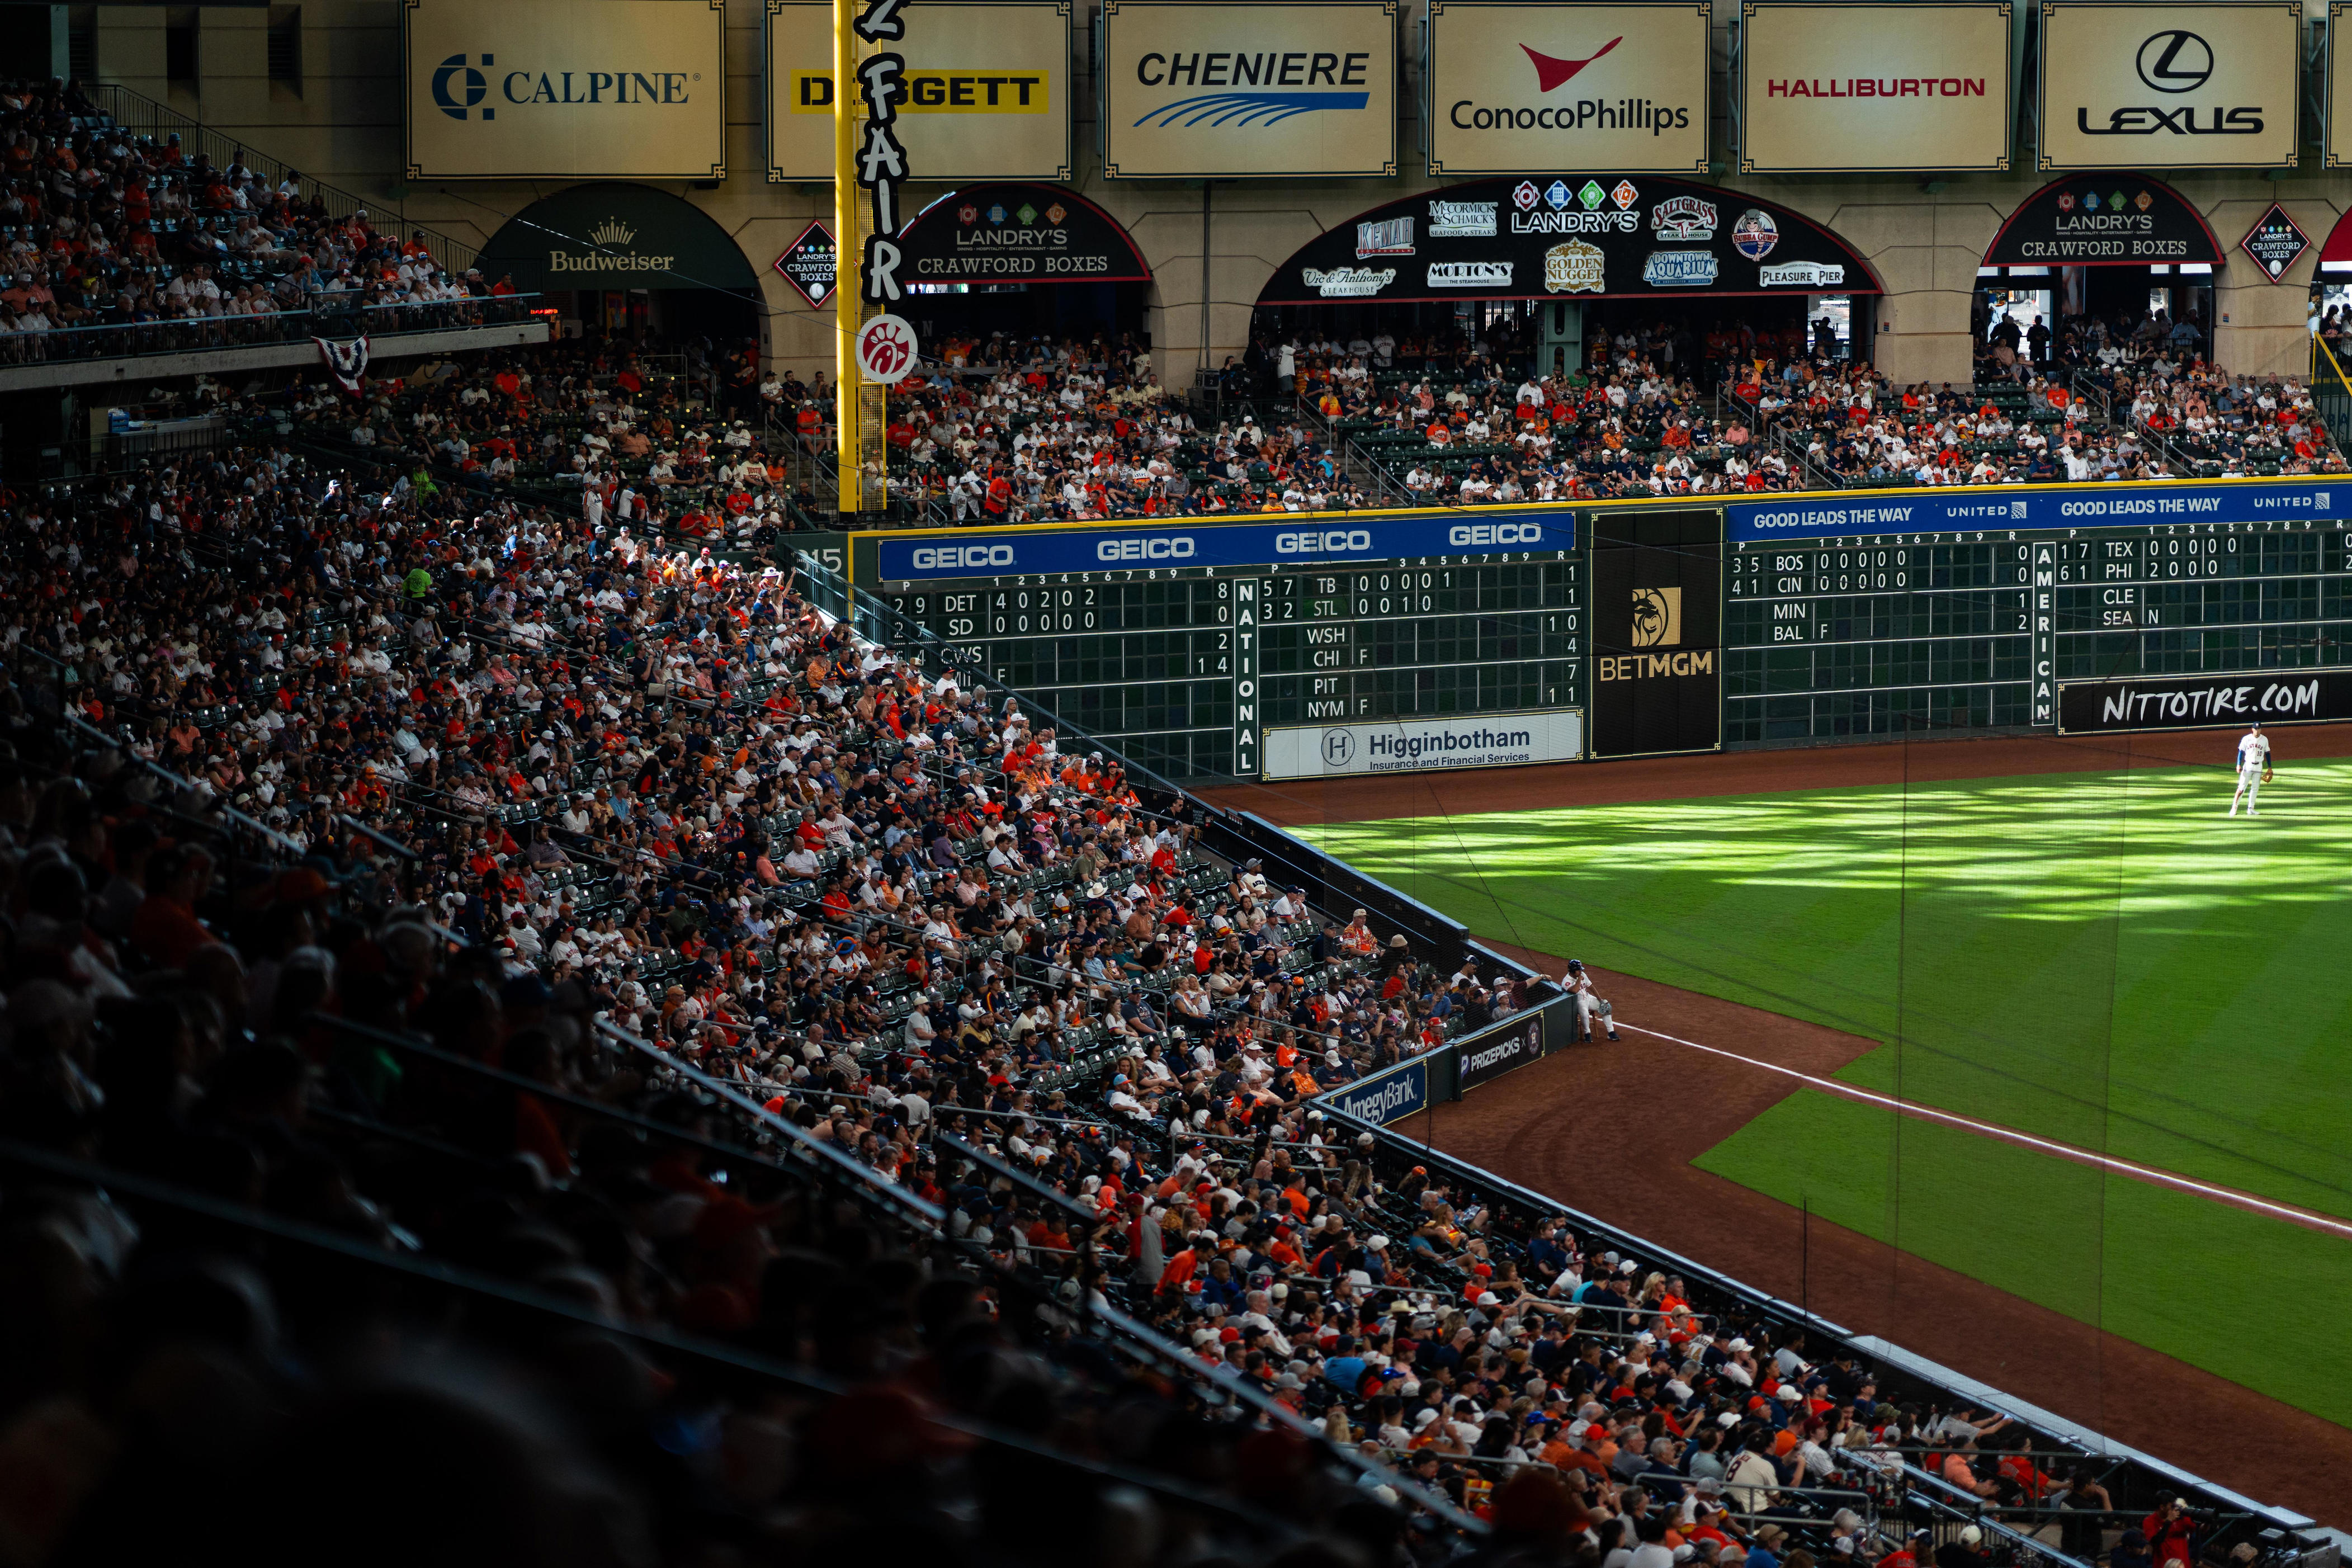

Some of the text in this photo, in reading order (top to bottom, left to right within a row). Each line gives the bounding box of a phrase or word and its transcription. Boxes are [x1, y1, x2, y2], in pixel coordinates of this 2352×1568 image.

[1137, 53, 1370, 86] CHENIERE
[503, 71, 689, 105] CALPINE
[801, 77, 1040, 105] DGETT
[1768, 78, 1985, 98] HALLIBURTON
[1450, 98, 1689, 136] ConocoPhillips
[2077, 107, 2264, 135] LEXUS
[1442, 212, 1495, 225] SCHMICK'S
[1513, 213, 1636, 230] LANDRY'S
[1653, 199, 1715, 227] SALTGRASS
[2056, 215, 2153, 230] LANDRY'S
[957, 230, 1067, 244] LANDRY'S
[1358, 218, 1414, 257] KEMAH
[1734, 232, 1778, 243] BUBBA GUMP
[2251, 242, 2301, 251] CRAWFORD
[1654, 252, 1711, 263] DOWNTOWN
[2022, 240, 2187, 257] CRAWFORD BOXES
[2262, 250, 2290, 258] BOXES
[550, 248, 674, 271] Budweiser
[787, 264, 837, 272] CRAWFOR
[918, 257, 1108, 273] CRAWFORD BOXES
[1547, 258, 1603, 269] GOLDEN
[1645, 258, 1717, 280] AQUARIUM
[1306, 270, 1391, 288] Vic & Anthony's
[1430, 263, 1508, 277] MORTON'S
[1547, 270, 1603, 280] NUGGET
[1762, 271, 1840, 283] PLEASURE PIER
[1323, 286, 1375, 294] STEAKHOUSE
[1947, 506, 2008, 517] UNITED
[2061, 498, 2220, 516] GOOD LEADS THE WAY
[2254, 497, 2312, 508] UNITED
[1754, 507, 1911, 528] GOOD LEADS THE WAY
[1276, 530, 1371, 554] GEICO
[1449, 523, 1541, 546] GEICO
[1097, 537, 1194, 561] GEICO
[2105, 537, 2236, 557] TEX 0 0 0 0 0
[913, 545, 1014, 569] GEICO
[1776, 550, 1906, 571] BOS 0 0 0 0 0
[2106, 560, 2217, 579] PHI 2 0 0 0
[1316, 572, 1449, 594] TB 0 0 0 0 1
[1778, 572, 1906, 593] CIN 0 0 0 0 0
[945, 589, 1094, 612] DET 4 0 2 0 2
[1314, 595, 1431, 616] STL 0 0 1 0
[2103, 588, 2134, 604] CLE
[1774, 603, 1806, 620] MIN
[2103, 609, 2159, 626] SEA N
[949, 612, 1094, 636] SD 0 0 0 0 0
[1774, 624, 1827, 641] BAL F
[1306, 627, 1345, 644] WSH
[2037, 549, 2052, 719] AMERICAN
[1314, 649, 1367, 667] CHI F
[1600, 651, 1712, 681] BETMGM
[1239, 585, 1254, 769] NATIONAL
[1315, 678, 1338, 695] PIT
[1308, 698, 1368, 717] NYM F
[2104, 679, 2318, 722] NITTOTIRE.COM
[1369, 728, 1530, 759] Higginbotham
[1369, 752, 1529, 771] Insurance and Financial Services
[1471, 1037, 1520, 1071] PRIZEPICKS
[1344, 1074, 1414, 1124] AmegyBank
